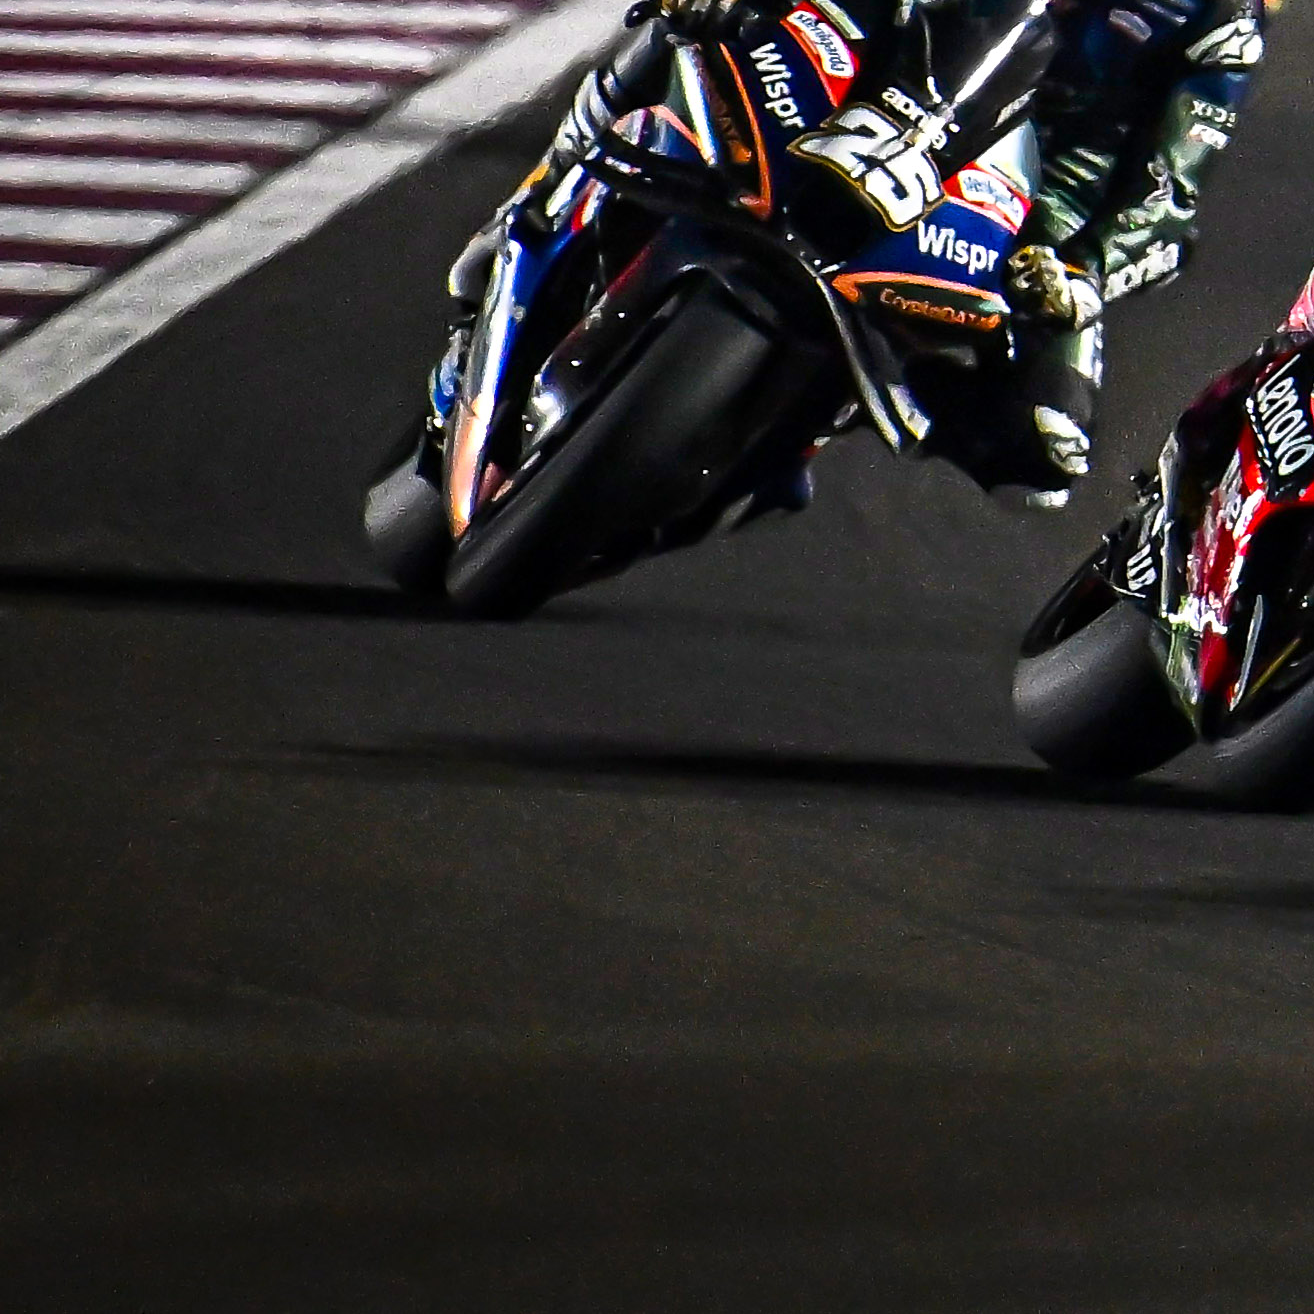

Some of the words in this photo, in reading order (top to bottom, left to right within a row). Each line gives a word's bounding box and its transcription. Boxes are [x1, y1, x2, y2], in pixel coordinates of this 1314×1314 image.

[749, 42, 806, 129] Wispr
[881, 86, 948, 151] apra
[797, 105, 947, 227] 25
[917, 220, 999, 276] Wispr
